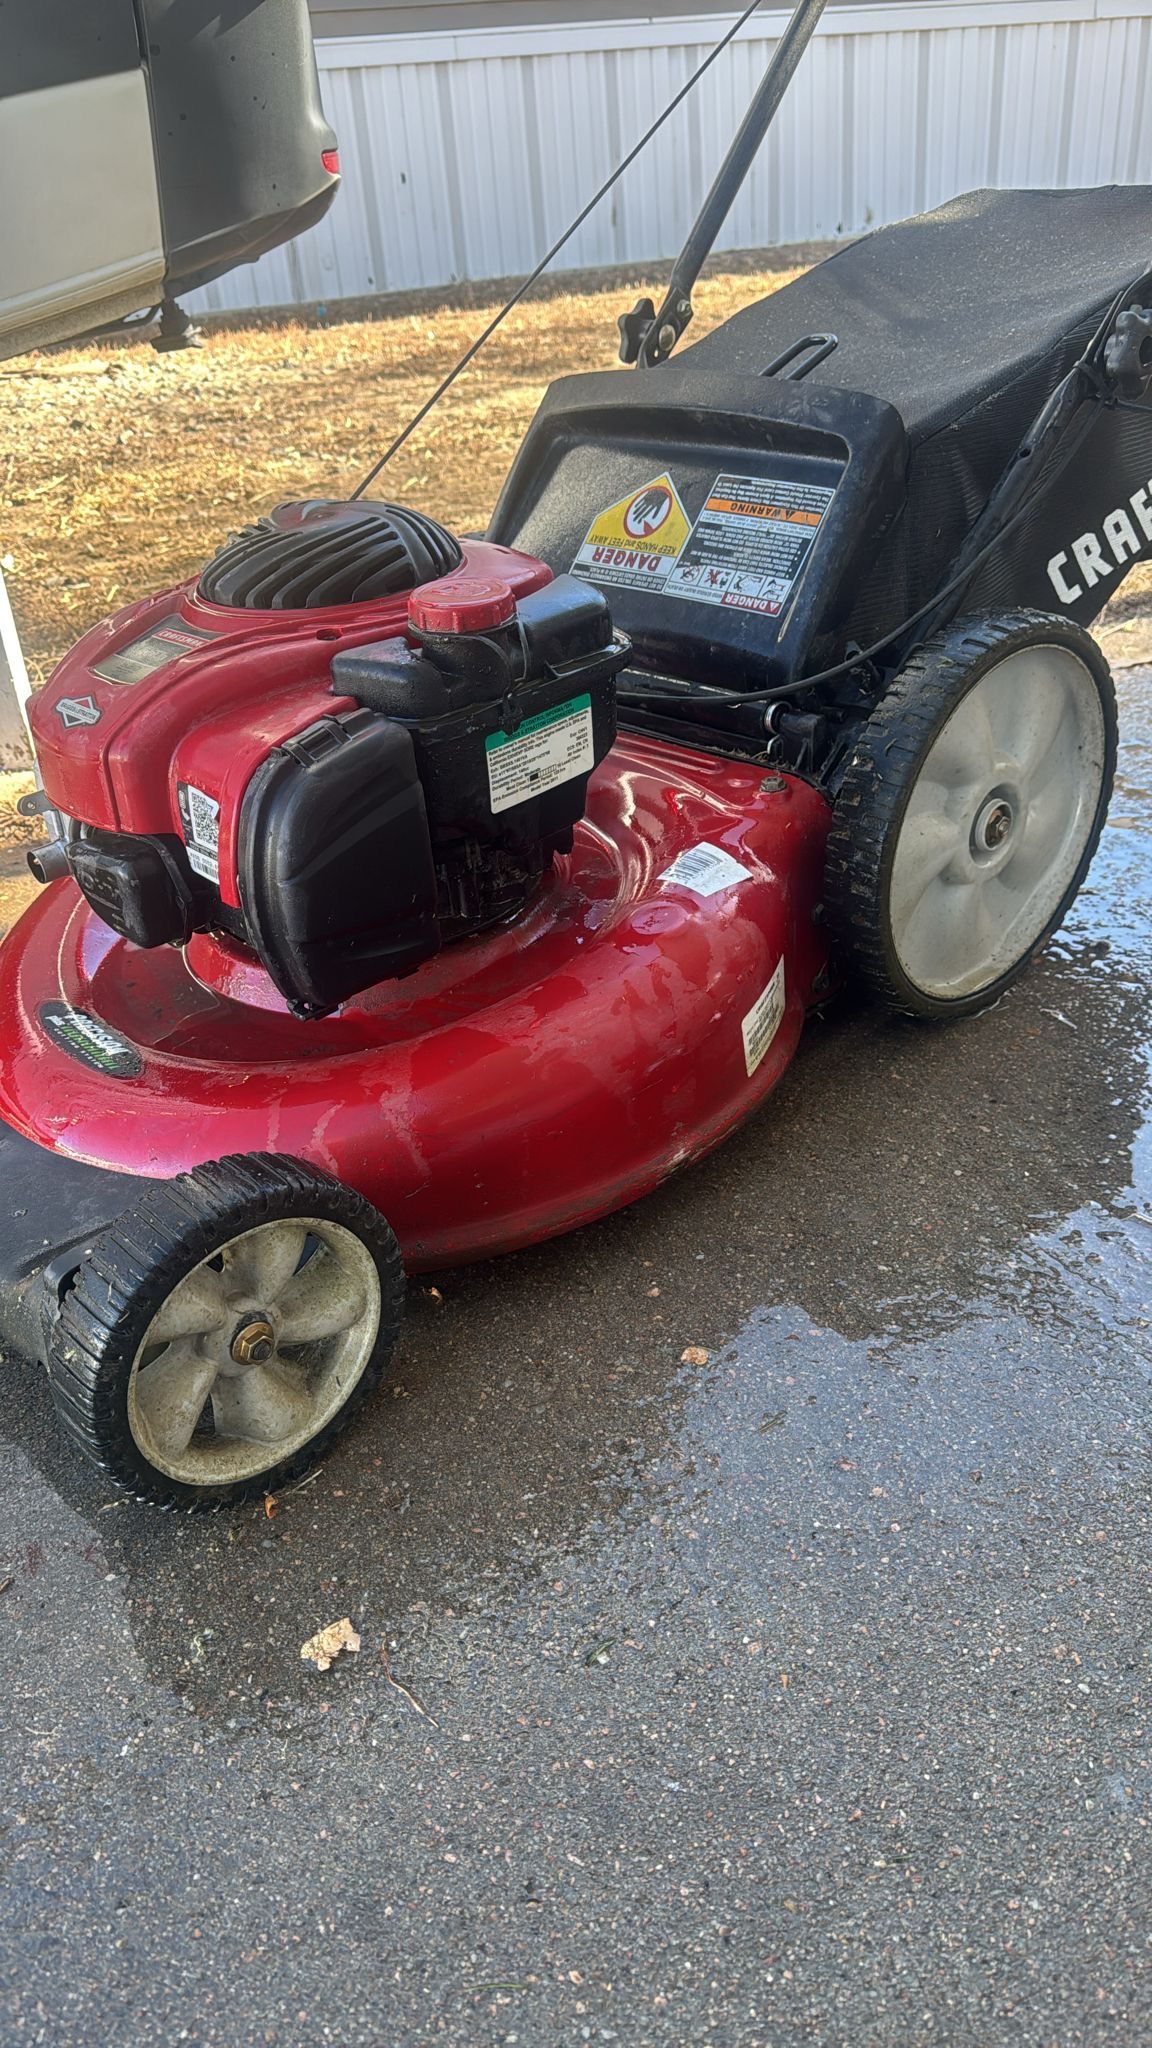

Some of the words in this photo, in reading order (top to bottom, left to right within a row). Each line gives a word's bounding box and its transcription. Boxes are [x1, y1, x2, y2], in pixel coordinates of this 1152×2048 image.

[728, 502, 781, 517] WARNING
[588, 534, 609, 544] AWAY
[607, 537, 624, 546] FEET
[622, 539, 636, 548] and
[1047, 479, 1152, 605] CRAF
[634, 541, 658, 552] HANDS
[656, 544, 676, 555] KEEP
[590, 546, 662, 572] DANGER
[724, 593, 768, 609] DANGER
